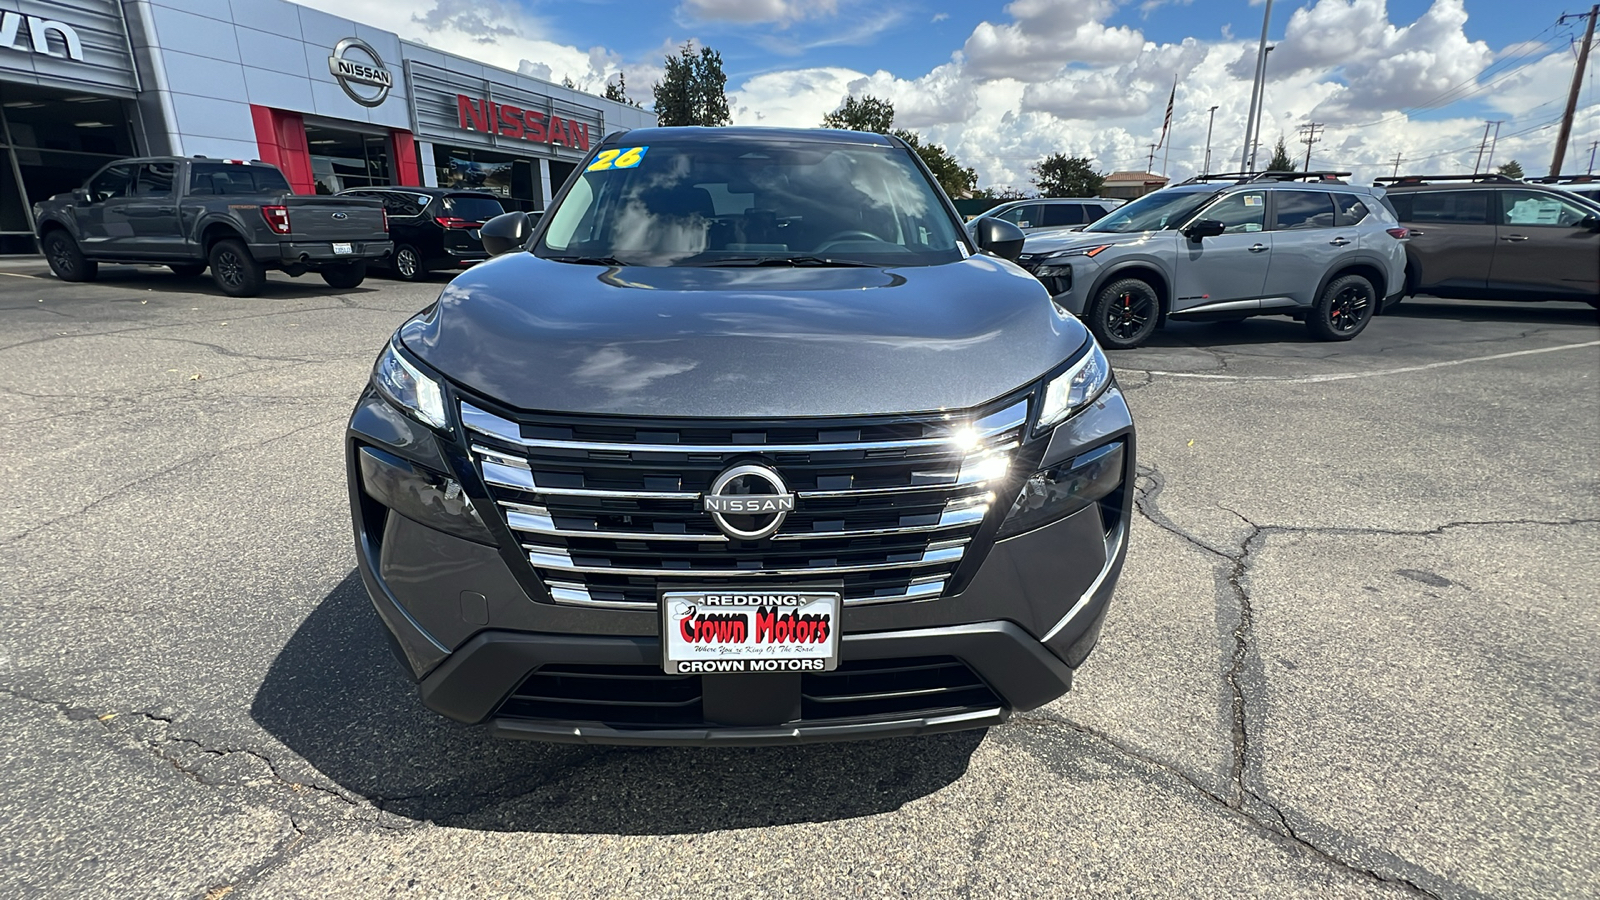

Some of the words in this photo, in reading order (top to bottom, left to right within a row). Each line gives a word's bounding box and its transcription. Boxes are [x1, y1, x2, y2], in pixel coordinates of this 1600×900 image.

[338, 61, 389, 83] NISSAN
[457, 94, 589, 152] NISSAN
[587, 147, 643, 171] 26
[706, 498, 792, 511] NISSAN
[707, 595, 797, 606] REDDING
[680, 606, 748, 643] Crown
[756, 606, 830, 643] Motors
[694, 645, 716, 653] Where
[718, 645, 742, 655] You're
[745, 646, 763, 655] King
[766, 645, 776, 655] Of
[778, 645, 791, 653] The
[794, 645, 814, 653] Road
[678, 660, 744, 672] CROWN
[750, 659, 824, 671] MOTORS
